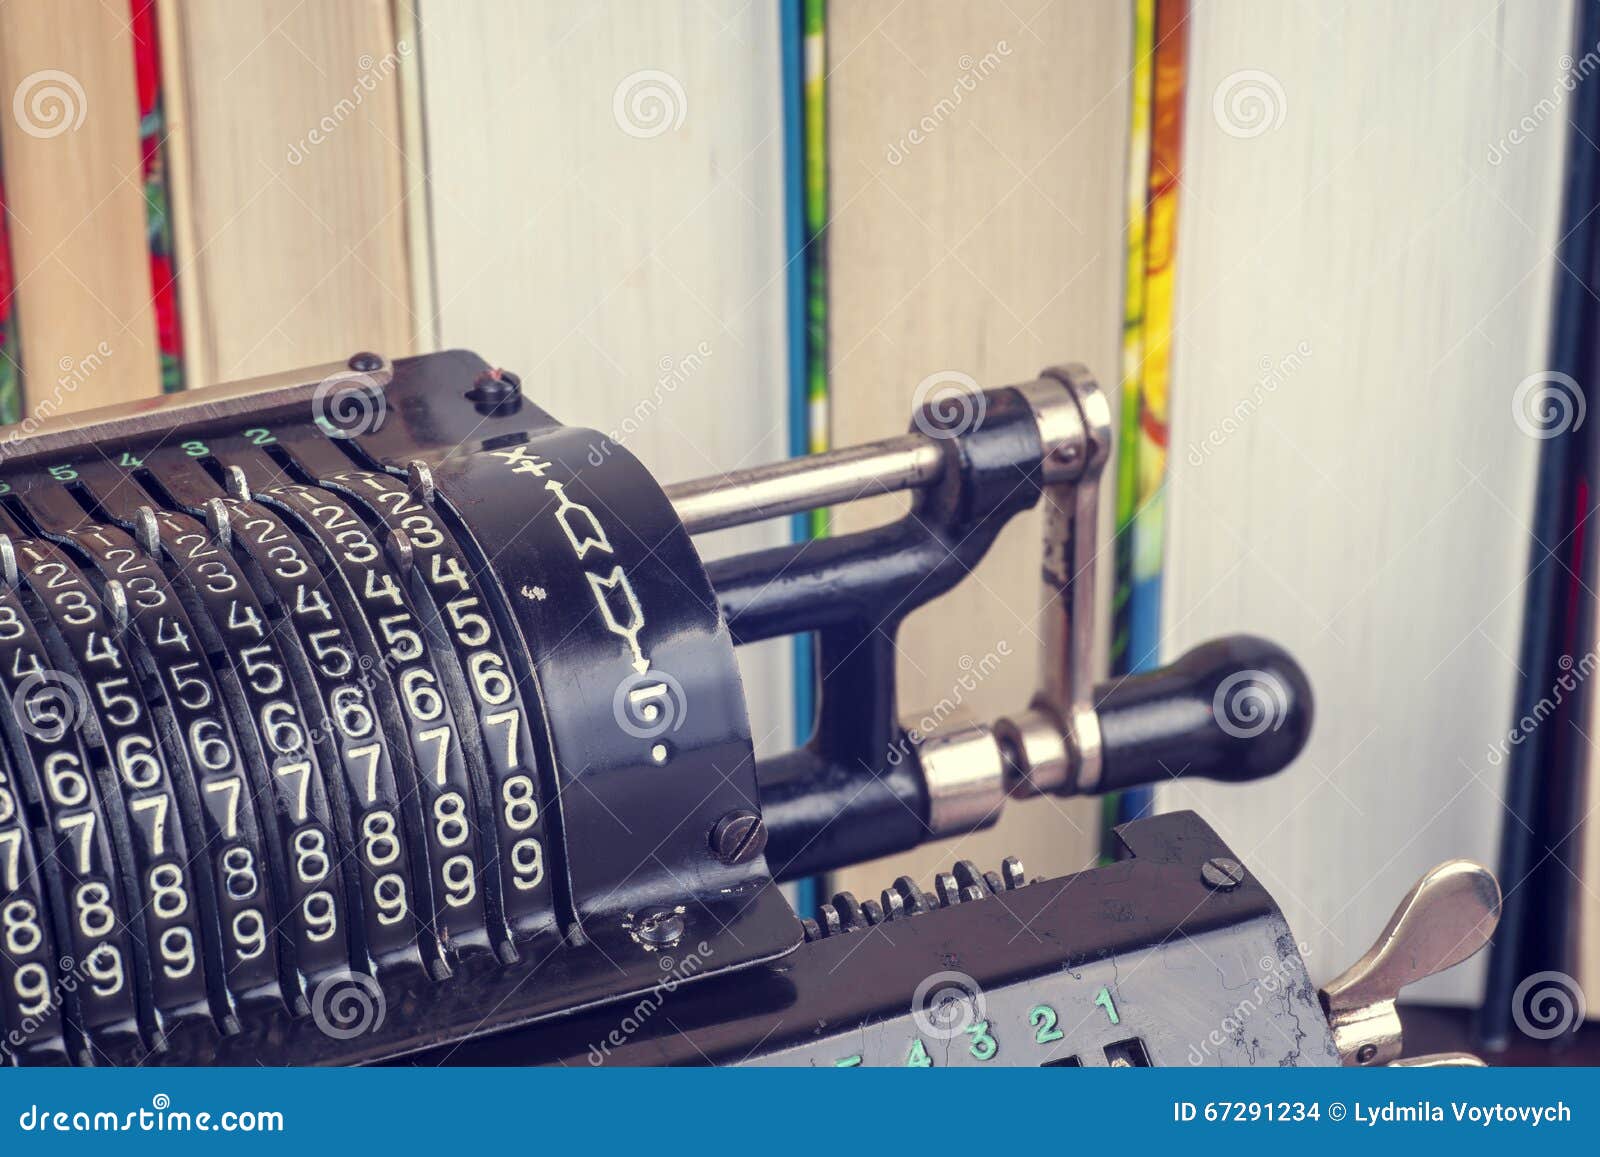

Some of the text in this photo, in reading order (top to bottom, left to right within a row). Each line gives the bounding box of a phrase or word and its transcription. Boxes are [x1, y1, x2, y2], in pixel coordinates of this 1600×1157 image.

[49, 464, 79, 481] 5
[120, 453, 143, 467] 4
[181, 441, 210, 456] 3
[244, 428, 277, 444] 2
[312, 505, 358, 530] 2
[378, 491, 423, 515] 2
[176, 534, 218, 559] 2
[245, 519, 288, 544] 2
[336, 530, 379, 563] 3
[401, 515, 444, 549] 3
[34, 563, 79, 588] 2
[105, 549, 147, 574] 2
[198, 561, 238, 593] 3
[268, 545, 308, 578] 3
[431, 553, 470, 591] 4
[56, 591, 97, 625] 3
[127, 577, 166, 607] 3
[297, 584, 332, 620] 4
[365, 569, 403, 606] 4
[158, 617, 191, 651] 4
[228, 600, 264, 637] 4
[379, 613, 424, 661] 5
[446, 597, 492, 647] 5
[13, 647, 46, 683] 4
[86, 632, 122, 669] 4
[241, 646, 283, 693] 5
[308, 628, 351, 677] 5
[96, 677, 139, 726] 5
[170, 662, 211, 709] 5
[402, 668, 443, 721] 6
[470, 652, 512, 705] 6
[263, 702, 303, 753] 6
[334, 687, 373, 737] 6
[118, 736, 160, 788] 6
[190, 720, 231, 770] 6
[419, 726, 451, 786] 7
[486, 708, 519, 768] 7
[46, 752, 88, 806] 6
[277, 761, 311, 820] 7
[348, 743, 381, 802] 7
[132, 794, 168, 855] 7
[206, 777, 241, 837] 7
[434, 791, 469, 848] 8
[502, 774, 539, 831] 8
[59, 811, 95, 874] 7
[294, 829, 330, 882] 8
[363, 810, 400, 866] 8
[224, 847, 258, 900] 8
[442, 854, 476, 908] 9
[511, 837, 545, 891] 9
[76, 882, 115, 937] 8
[150, 864, 188, 919] 8
[303, 890, 337, 942] 9
[374, 873, 408, 925] 9
[3, 900, 41, 954] 8
[160, 926, 195, 978] 9
[232, 909, 266, 959] 9
[14, 962, 50, 1015] 9
[88, 945, 124, 996] 9
[909, 986, 1119, 1067] 4 3 2 1
